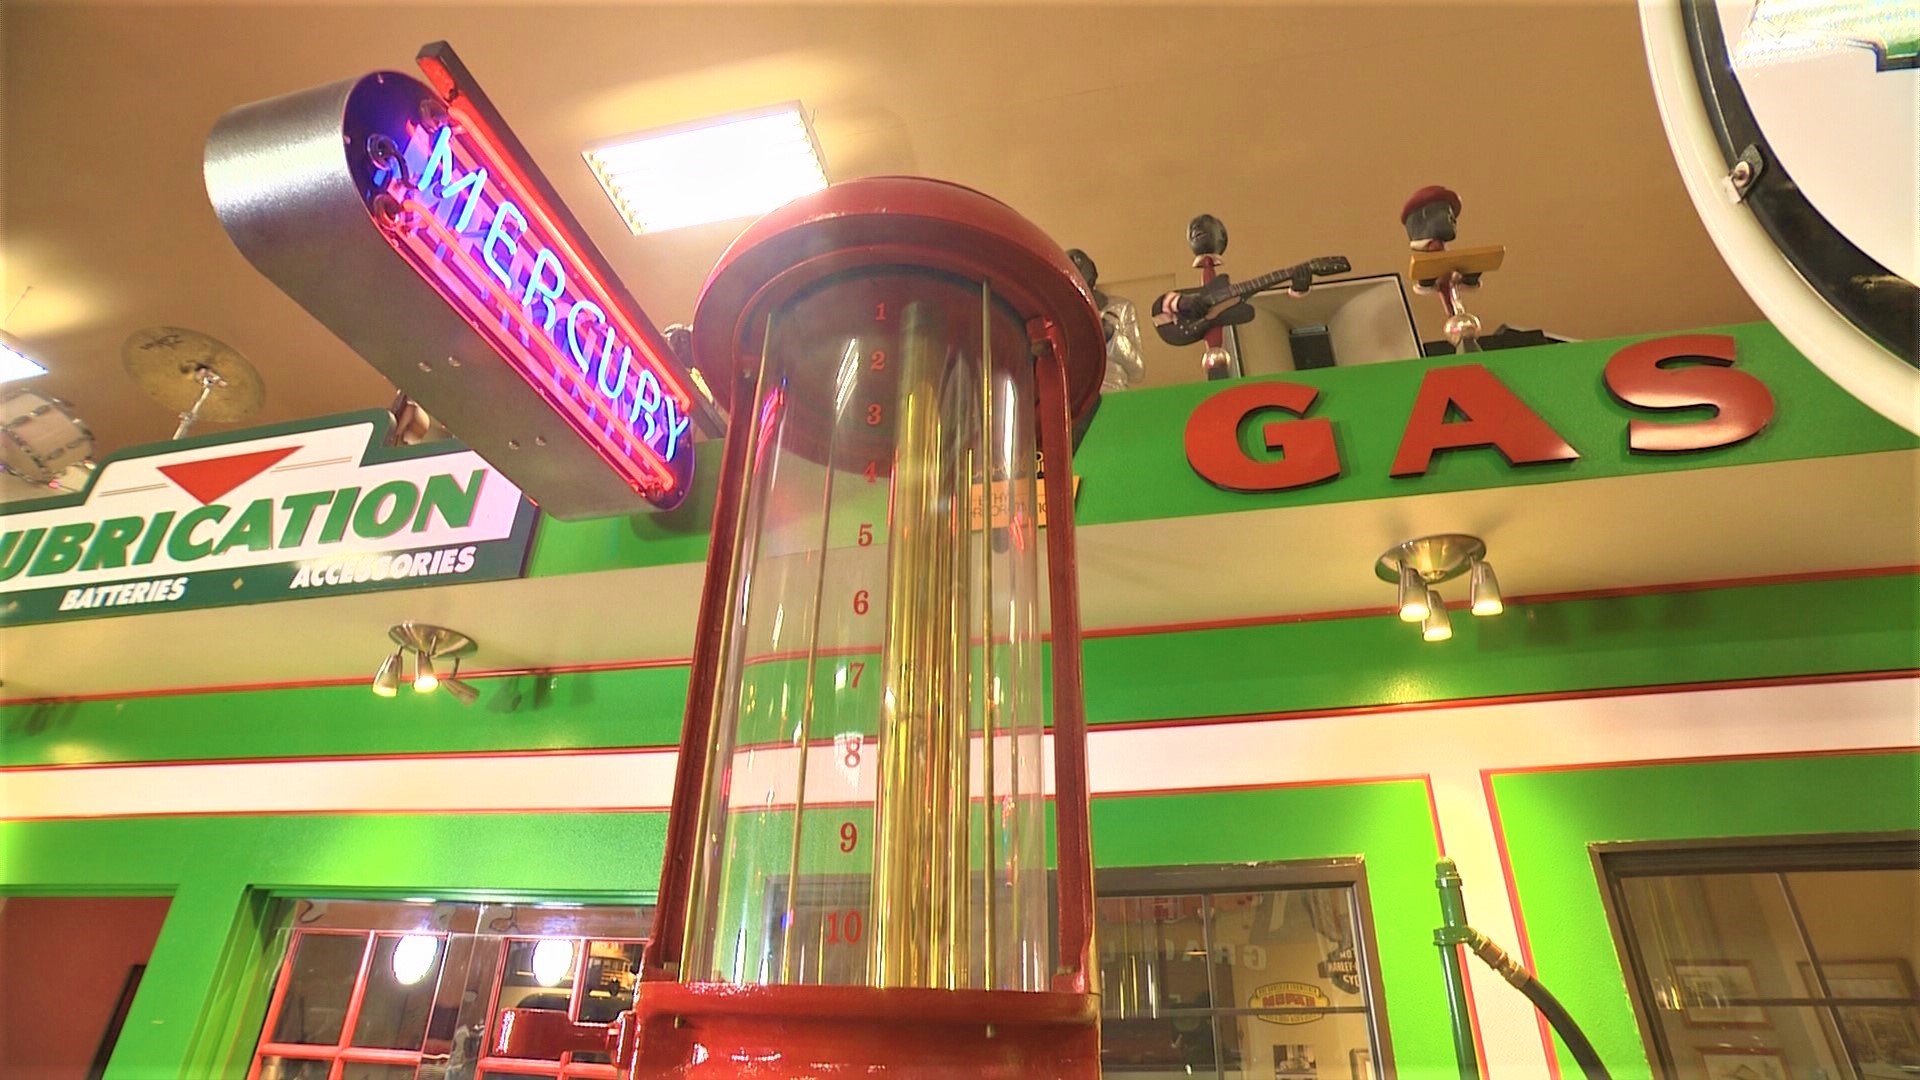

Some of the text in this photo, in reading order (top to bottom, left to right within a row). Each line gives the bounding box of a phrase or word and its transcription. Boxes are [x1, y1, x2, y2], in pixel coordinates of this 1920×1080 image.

[418, 126, 688, 462] MERCURY
[874, 303, 887, 320] 1
[871, 351, 886, 370] 2
[867, 404, 881, 425] 3
[1184, 334, 1775, 493] GAS
[863, 462, 877, 483] 4
[858, 524, 873, 547] 5
[58, 546, 477, 612] BATTERIES ACCESSORIES
[853, 590, 869, 615] 6
[849, 662, 865, 689] 7
[844, 737, 861, 768] 8
[840, 822, 858, 853] 9
[825, 911, 863, 945] 10
